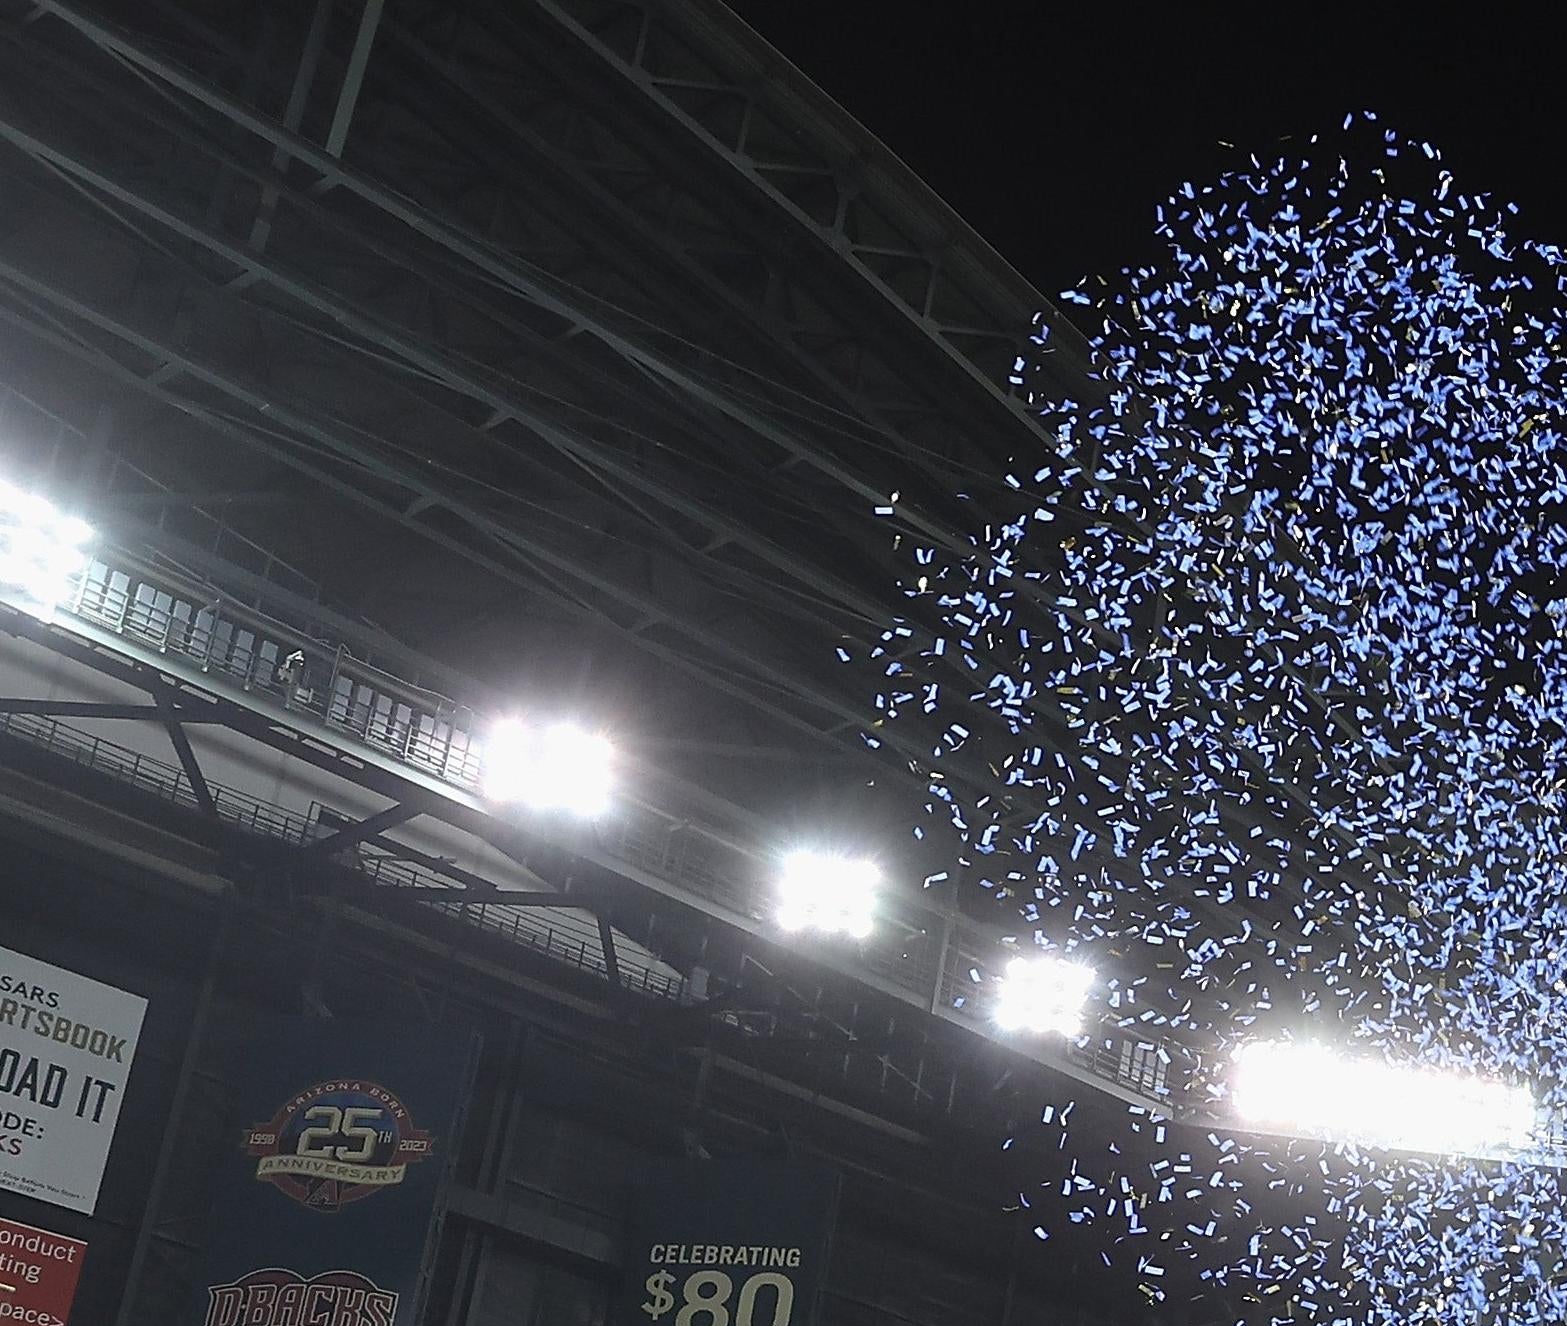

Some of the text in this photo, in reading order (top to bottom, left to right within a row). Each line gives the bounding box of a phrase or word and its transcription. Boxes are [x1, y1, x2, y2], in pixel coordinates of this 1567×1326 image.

[76, 1075, 116, 1124] IT
[369, 1087, 405, 1119] BORN
[296, 1106, 383, 1162] 25
[400, 1140, 427, 1152] 2023
[263, 1158, 401, 1182] ANNIVERSARY
[650, 1243, 802, 1269] CELEBRATING
